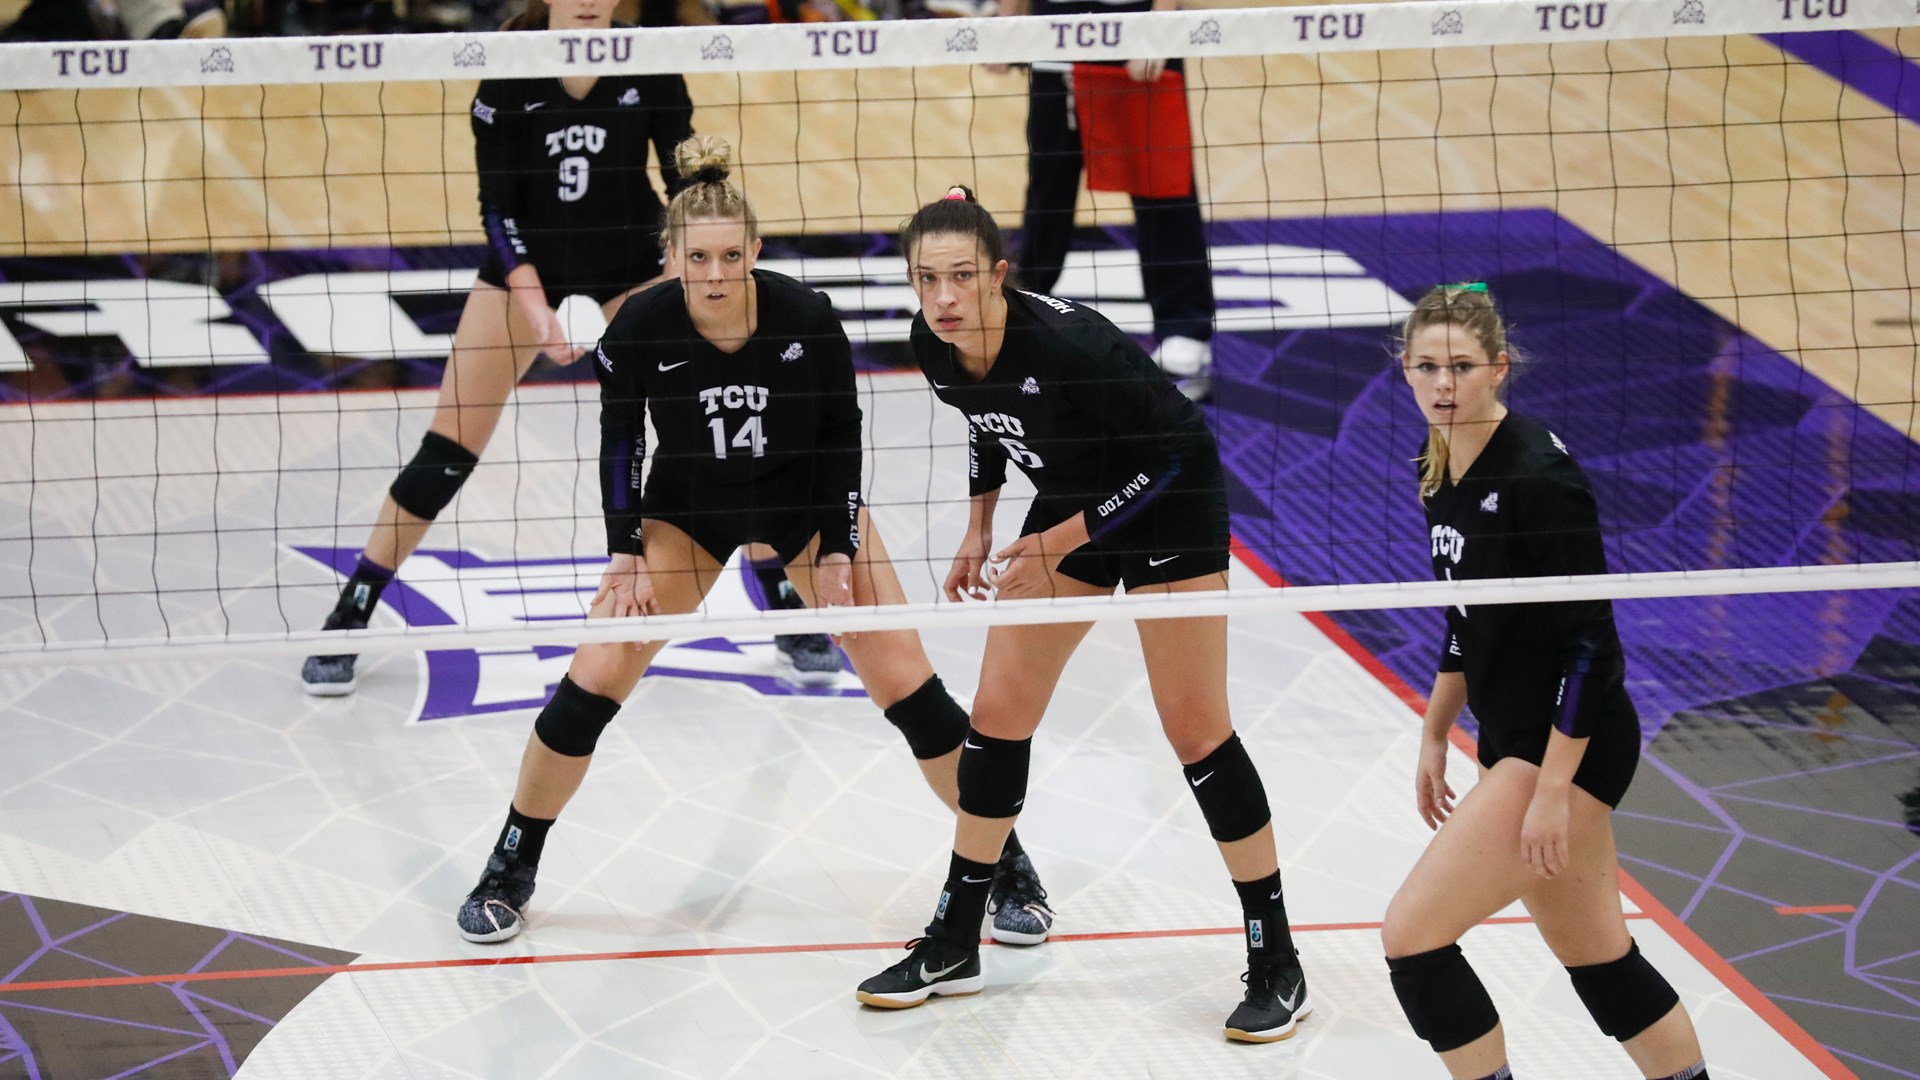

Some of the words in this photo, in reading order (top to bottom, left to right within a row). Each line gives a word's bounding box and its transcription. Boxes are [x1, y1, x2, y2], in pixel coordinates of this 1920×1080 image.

[1536, 3, 1606, 31] TCU
[1779, 0, 1847, 20] TCU
[1051, 22, 1122, 48] TCU
[1294, 14, 1364, 40] TCU
[310, 43, 382, 70] TCU
[561, 37, 632, 64] TCU
[808, 30, 878, 56] TCU
[53, 49, 129, 76] TCU
[546, 125, 607, 156] TCU
[558, 156, 589, 202] 9
[700, 385, 769, 415] TCU
[708, 416, 768, 459] 14
[969, 412, 1025, 437] TCU
[970, 447, 979, 478] RIFF
[1122, 473, 1150, 499] BAH
[1097, 494, 1125, 517] ZOO
[1431, 525, 1464, 564] TCU
